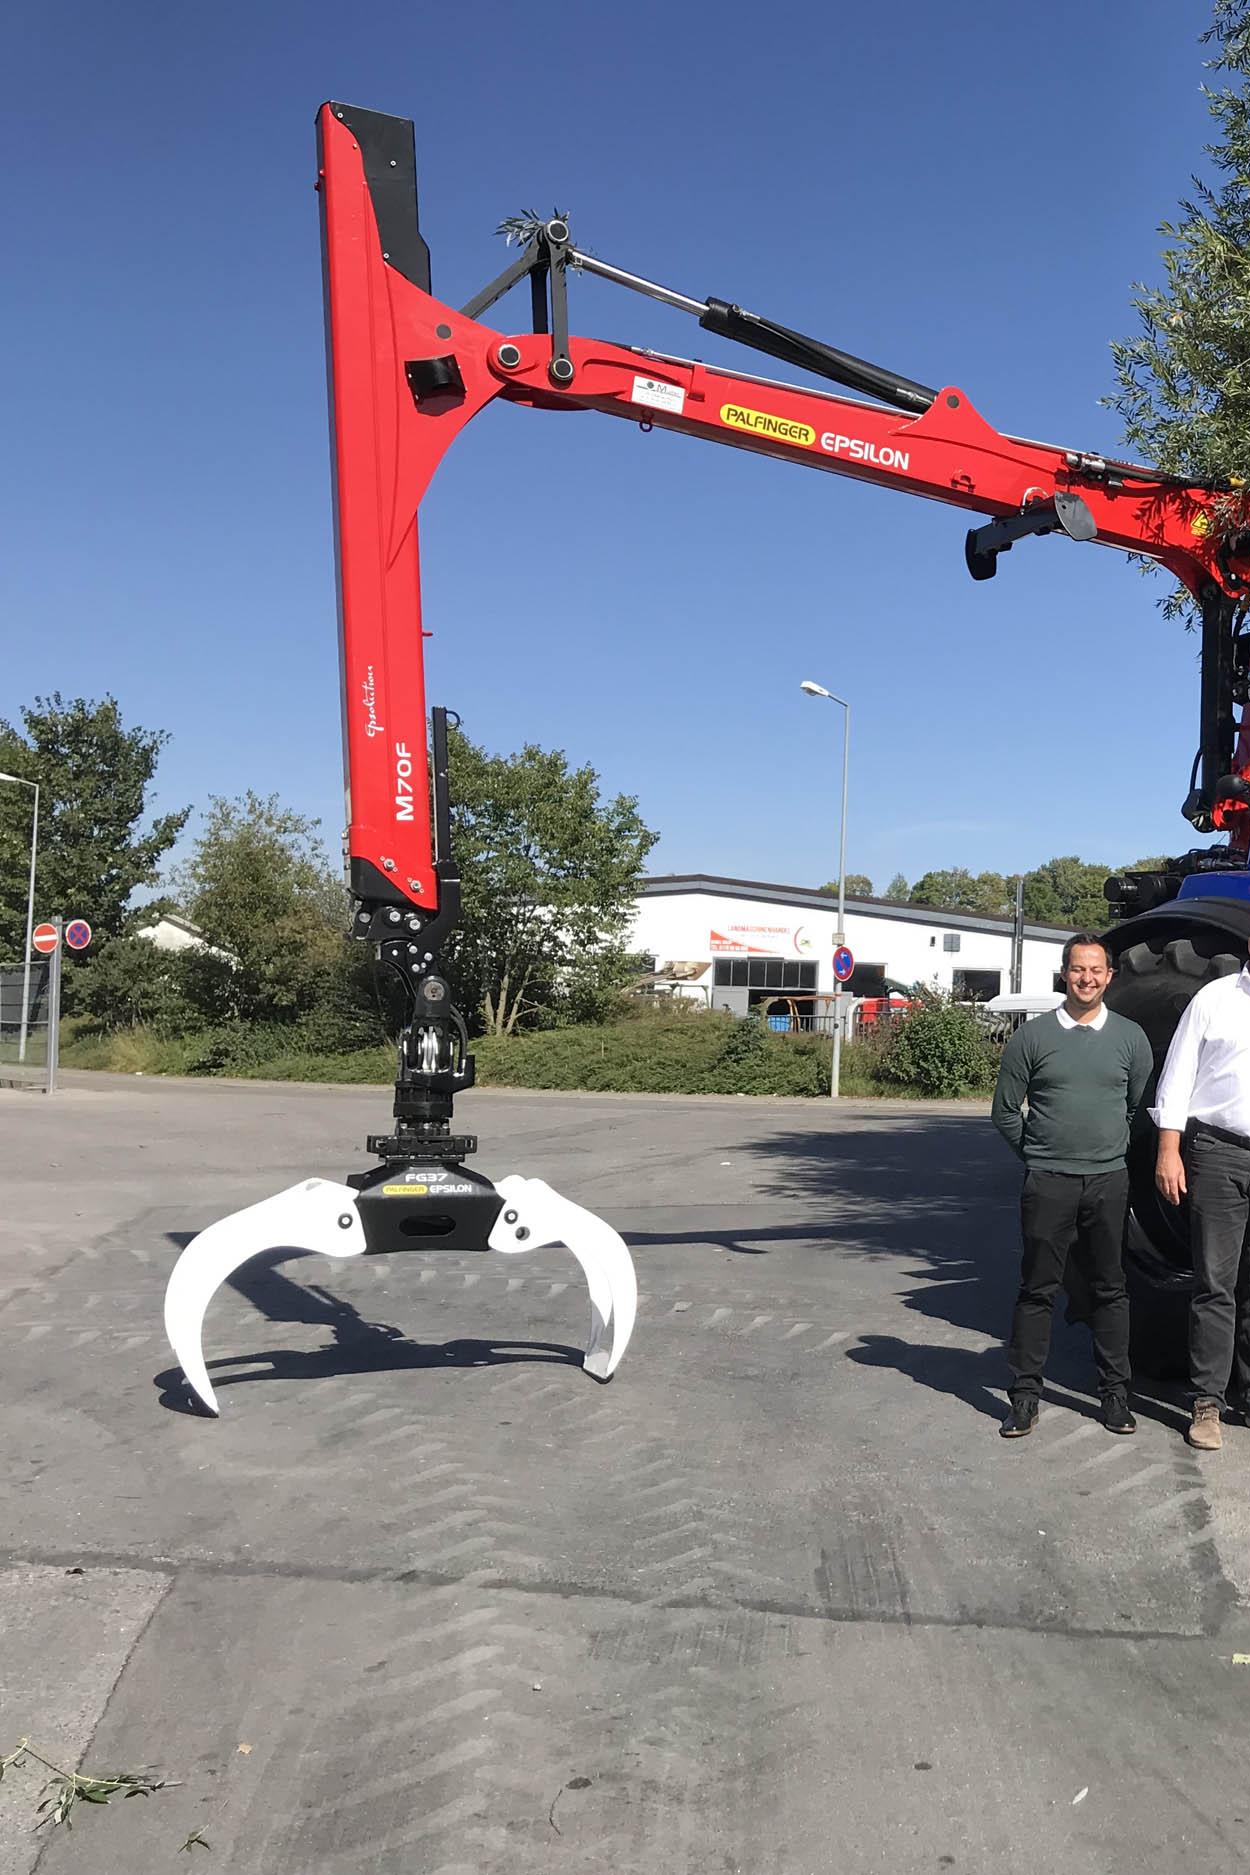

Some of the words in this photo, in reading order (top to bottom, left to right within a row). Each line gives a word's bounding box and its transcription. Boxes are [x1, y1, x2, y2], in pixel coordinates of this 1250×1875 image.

[726, 407, 810, 442] PALFINGER
[820, 431, 910, 471] EPSILON
[395, 742, 415, 821] M70F
[405, 1172, 448, 1182] FG37
[429, 1183, 472, 1193] EPSILON
